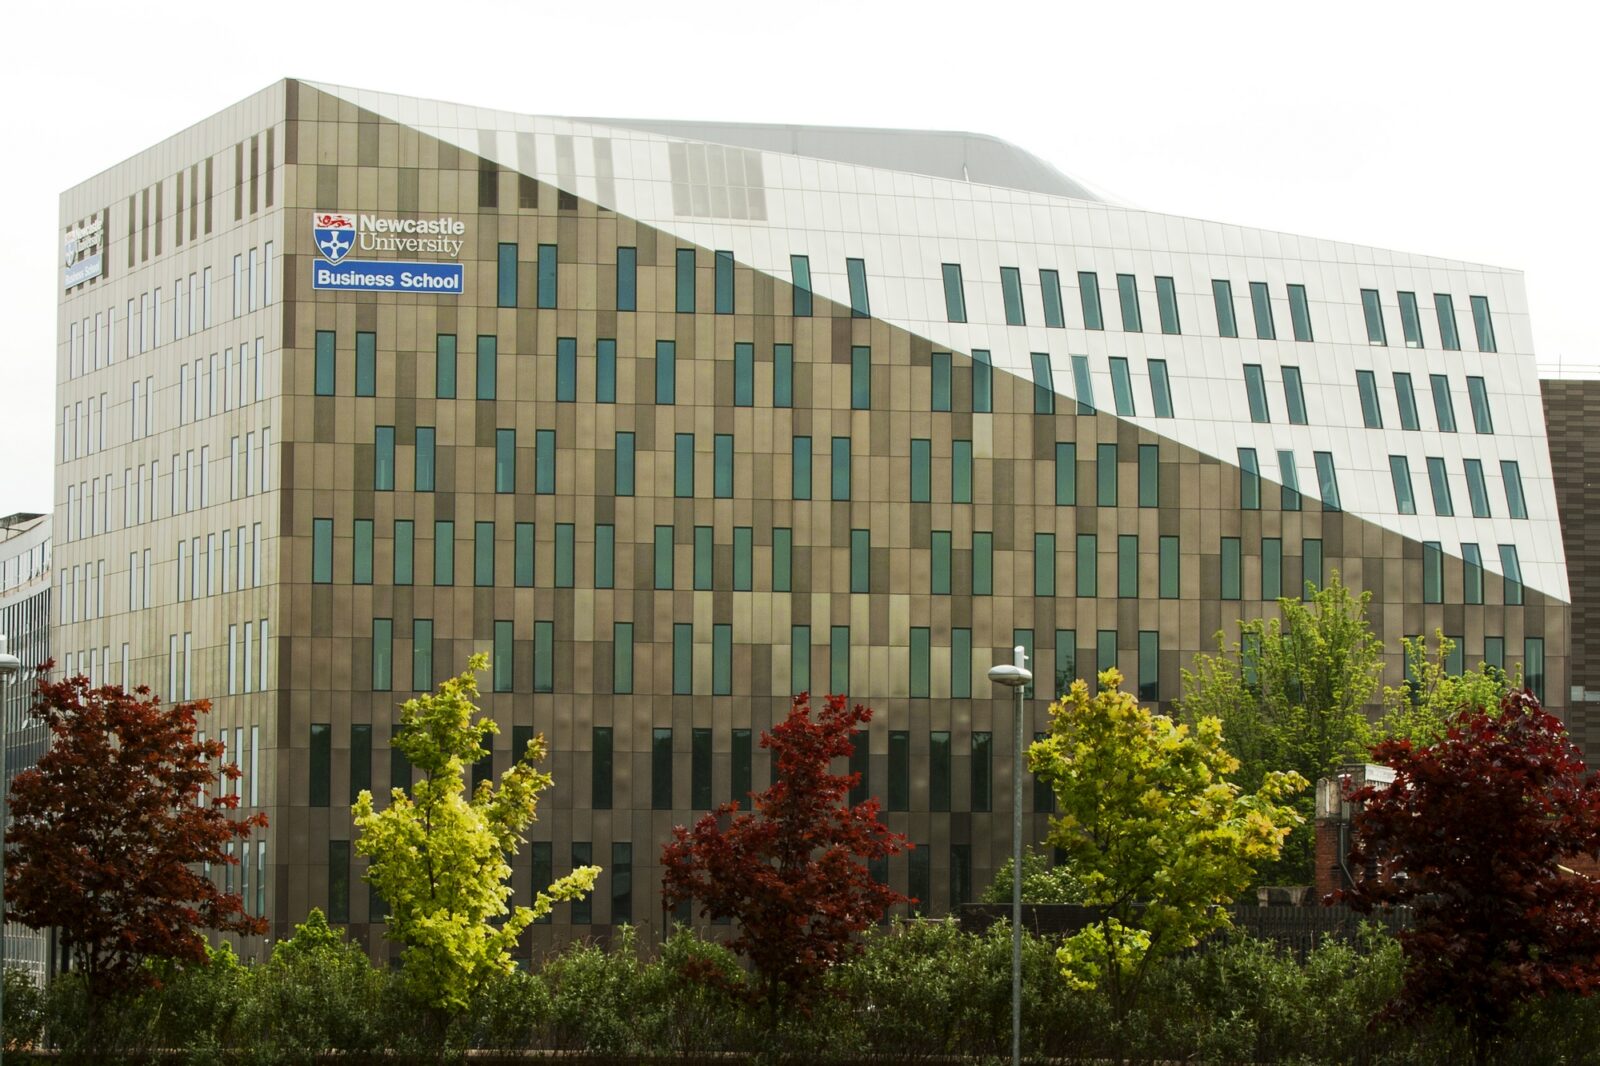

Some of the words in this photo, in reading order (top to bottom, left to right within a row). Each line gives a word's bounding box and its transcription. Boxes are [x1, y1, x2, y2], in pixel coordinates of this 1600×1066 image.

[360, 215, 465, 235] Newcastle
[358, 232, 464, 257] University
[318, 269, 395, 287] Business
[400, 272, 459, 289] School
